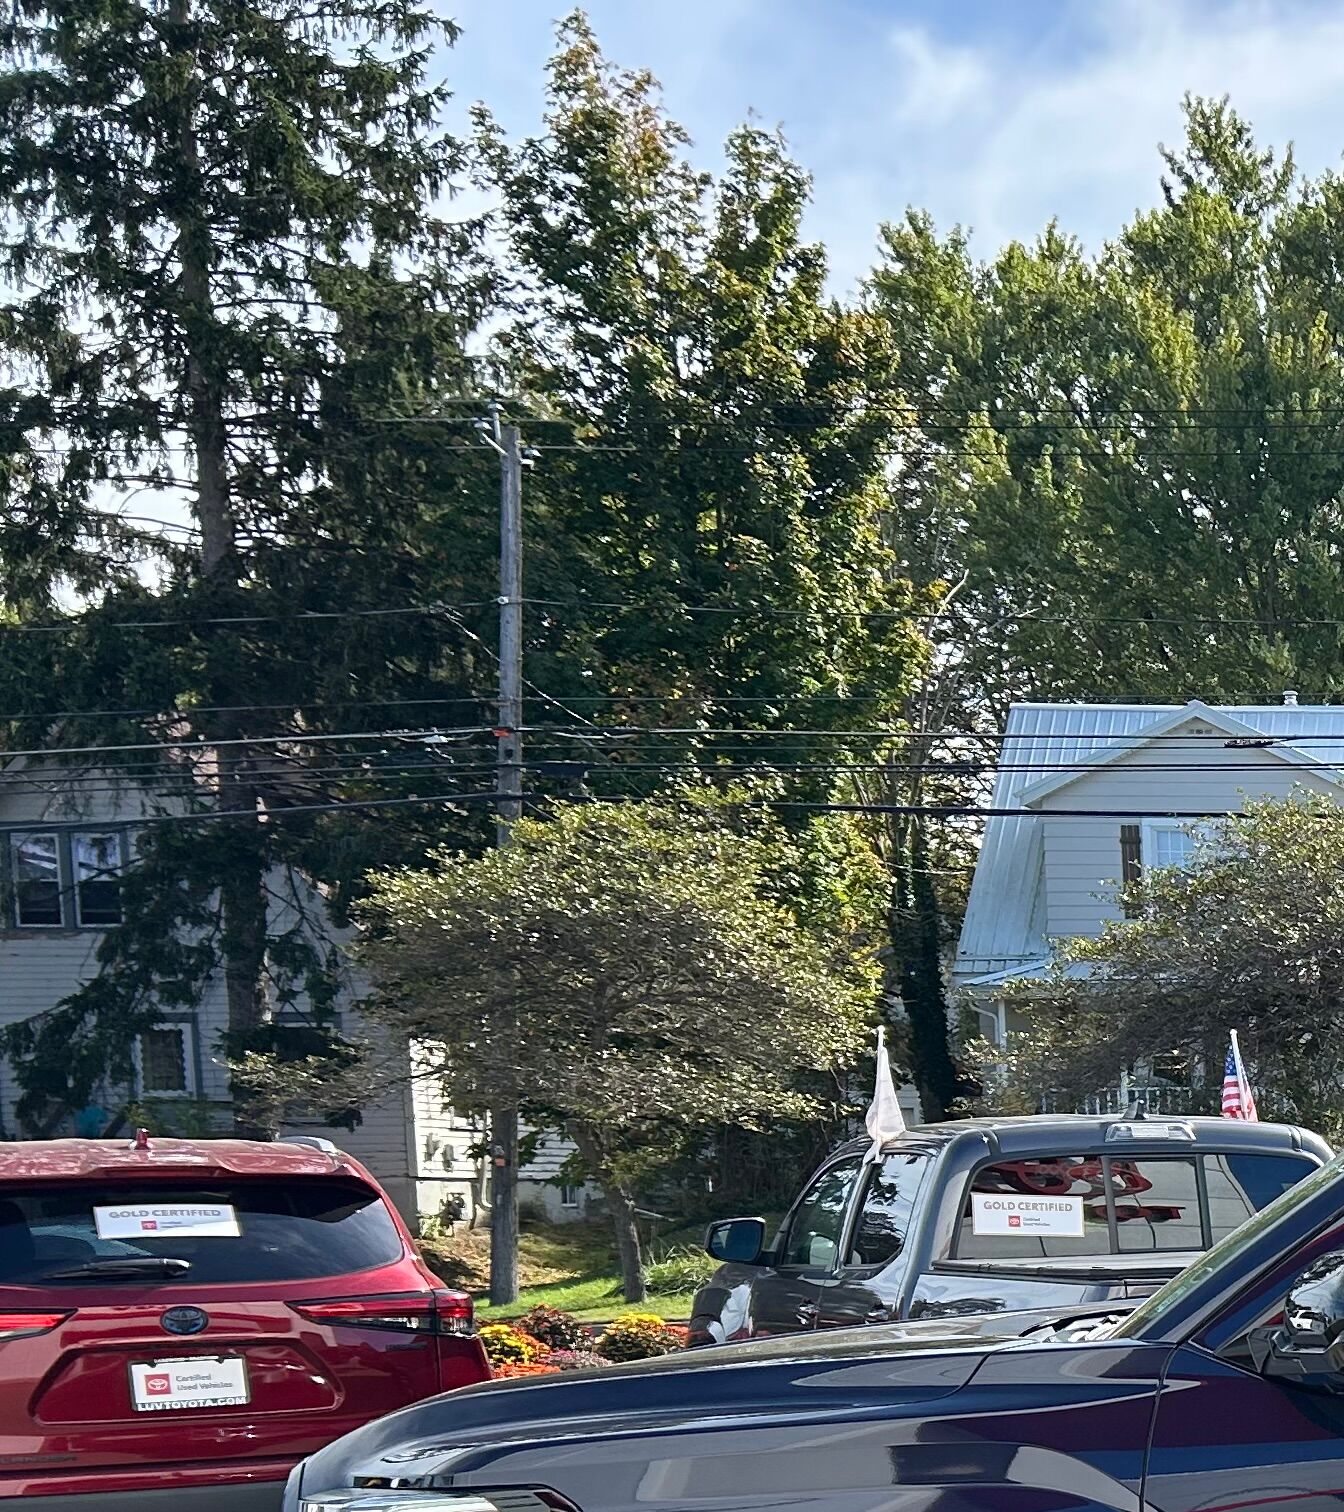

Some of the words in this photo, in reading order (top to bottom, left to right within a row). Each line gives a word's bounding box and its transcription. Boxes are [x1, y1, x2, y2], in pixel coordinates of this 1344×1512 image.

[983, 1201, 1016, 1210] GOLD
[1018, 1202, 1073, 1212] CERTIFIED
[109, 1209, 149, 1218] GOLD
[151, 1209, 221, 1217] CERTIFIED
[176, 1374, 212, 1382] Certified
[137, 1396, 247, 1412] LUVTOYOTA.COM
